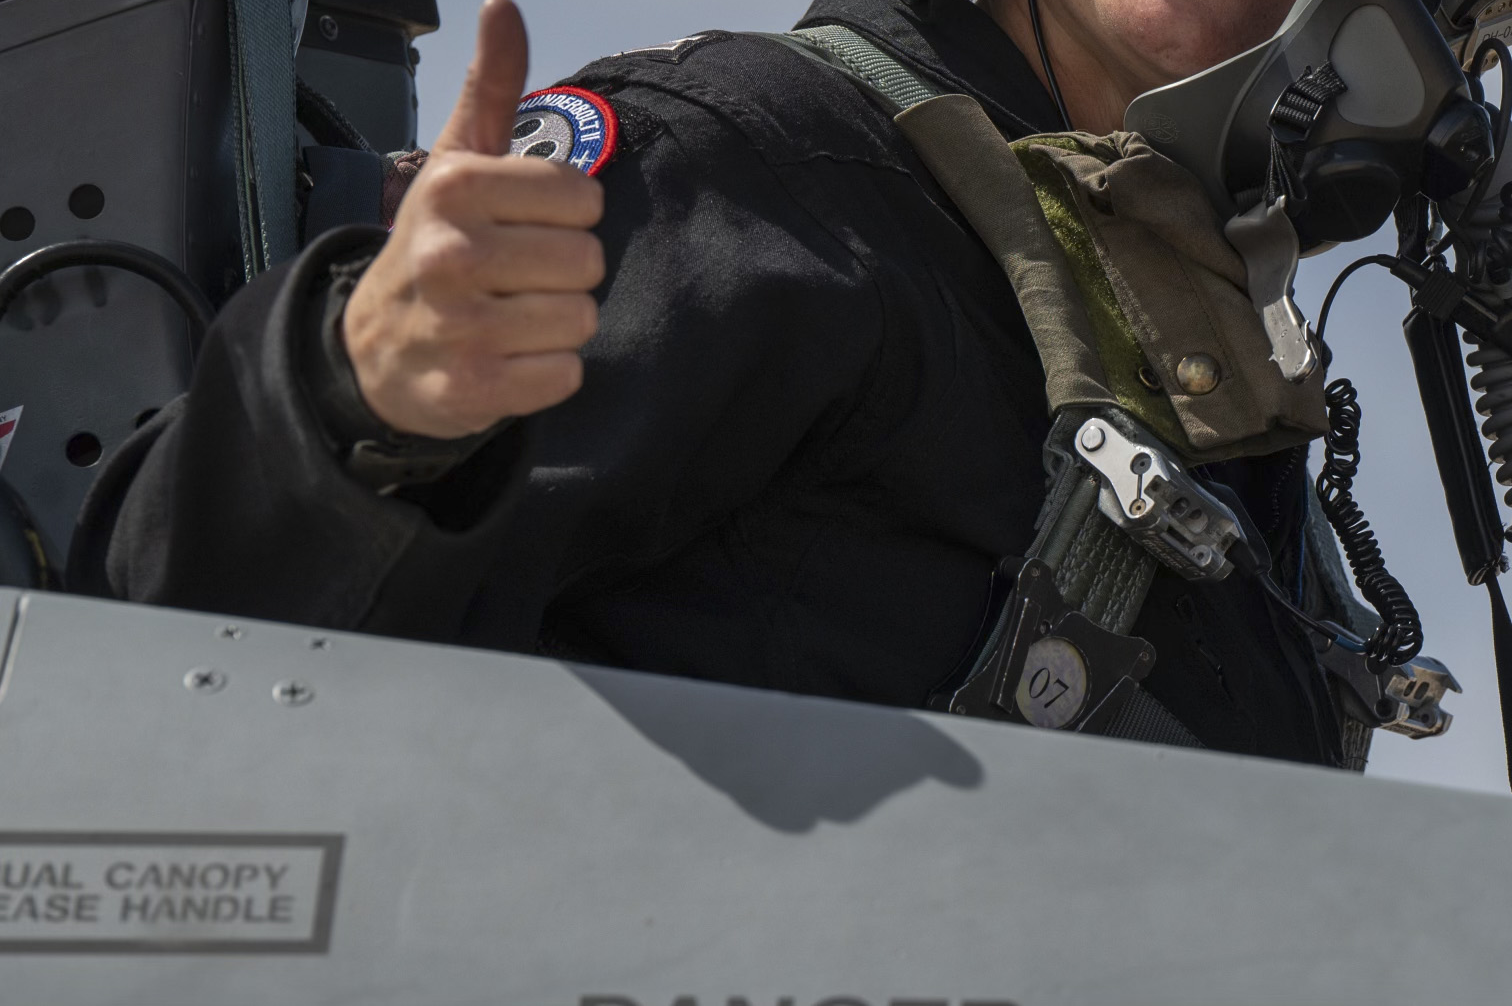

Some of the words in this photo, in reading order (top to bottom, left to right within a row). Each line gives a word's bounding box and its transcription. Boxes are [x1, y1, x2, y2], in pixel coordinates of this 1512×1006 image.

[517, 94, 600, 131] HUNDERBOLT
[1029, 667, 1069, 709] 07
[104, 861, 290, 891] CANOPY
[120, 895, 295, 924] HANDLE
